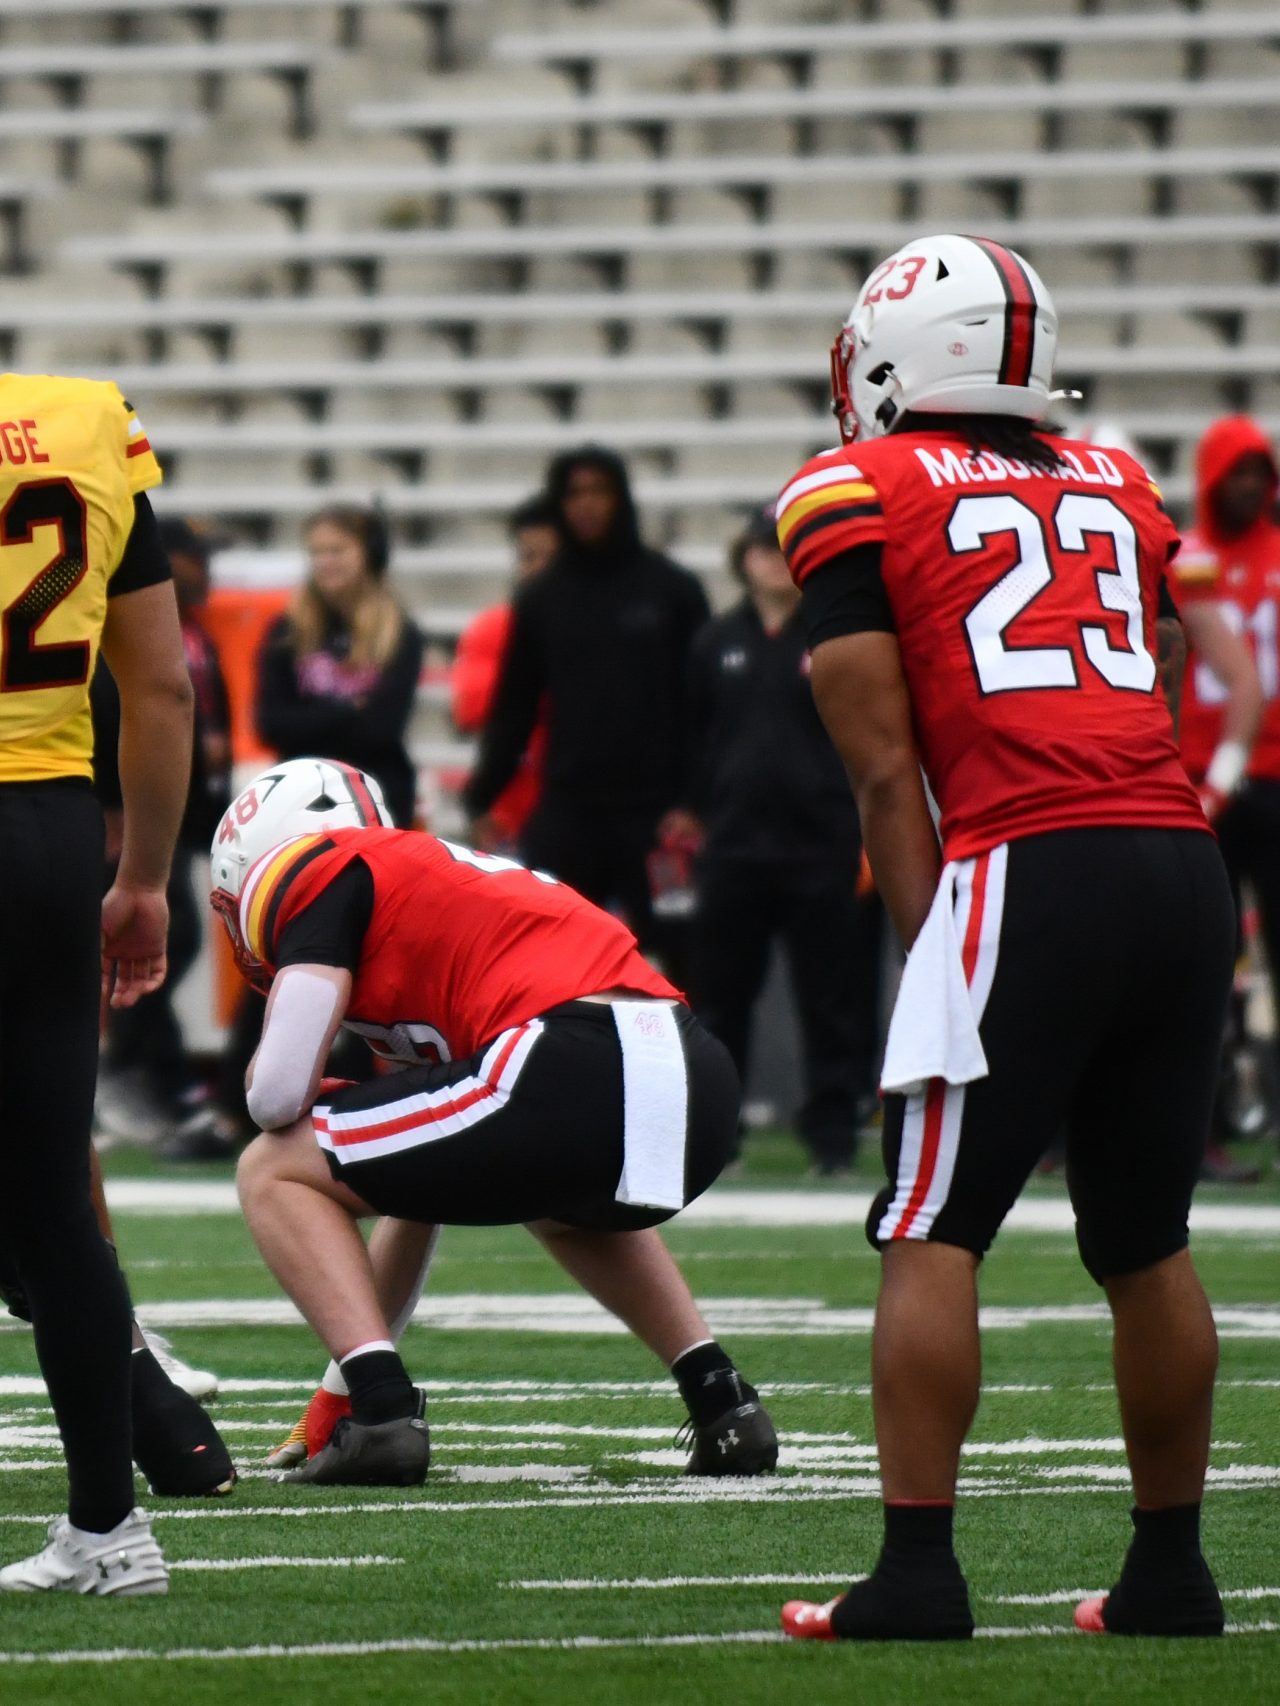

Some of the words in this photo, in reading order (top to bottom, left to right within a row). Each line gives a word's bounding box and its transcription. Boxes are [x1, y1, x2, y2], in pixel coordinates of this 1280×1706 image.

[863, 256, 927, 306] 23
[946, 488, 1158, 698] 23
[218, 787, 259, 845] 48
